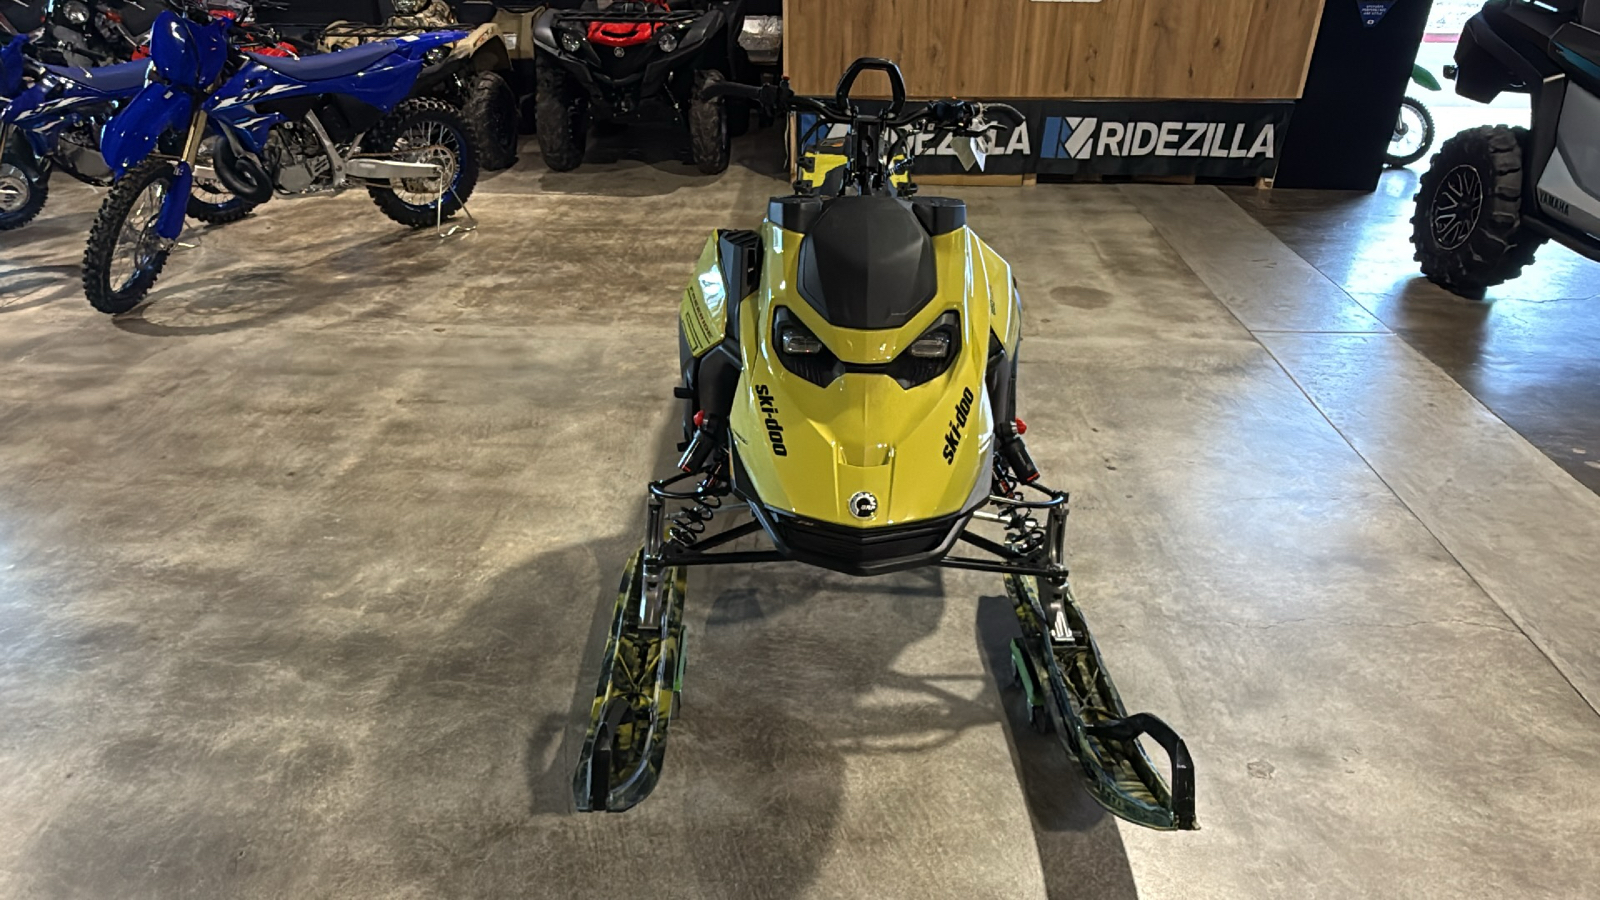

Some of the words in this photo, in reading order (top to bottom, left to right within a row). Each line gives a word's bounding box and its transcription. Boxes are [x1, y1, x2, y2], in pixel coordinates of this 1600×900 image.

[1096, 121, 1275, 158] RIDEZILLA
[1539, 190, 1569, 217] YAMAHA
[755, 384, 787, 457] ski-doo
[943, 386, 974, 465] ski-doo
